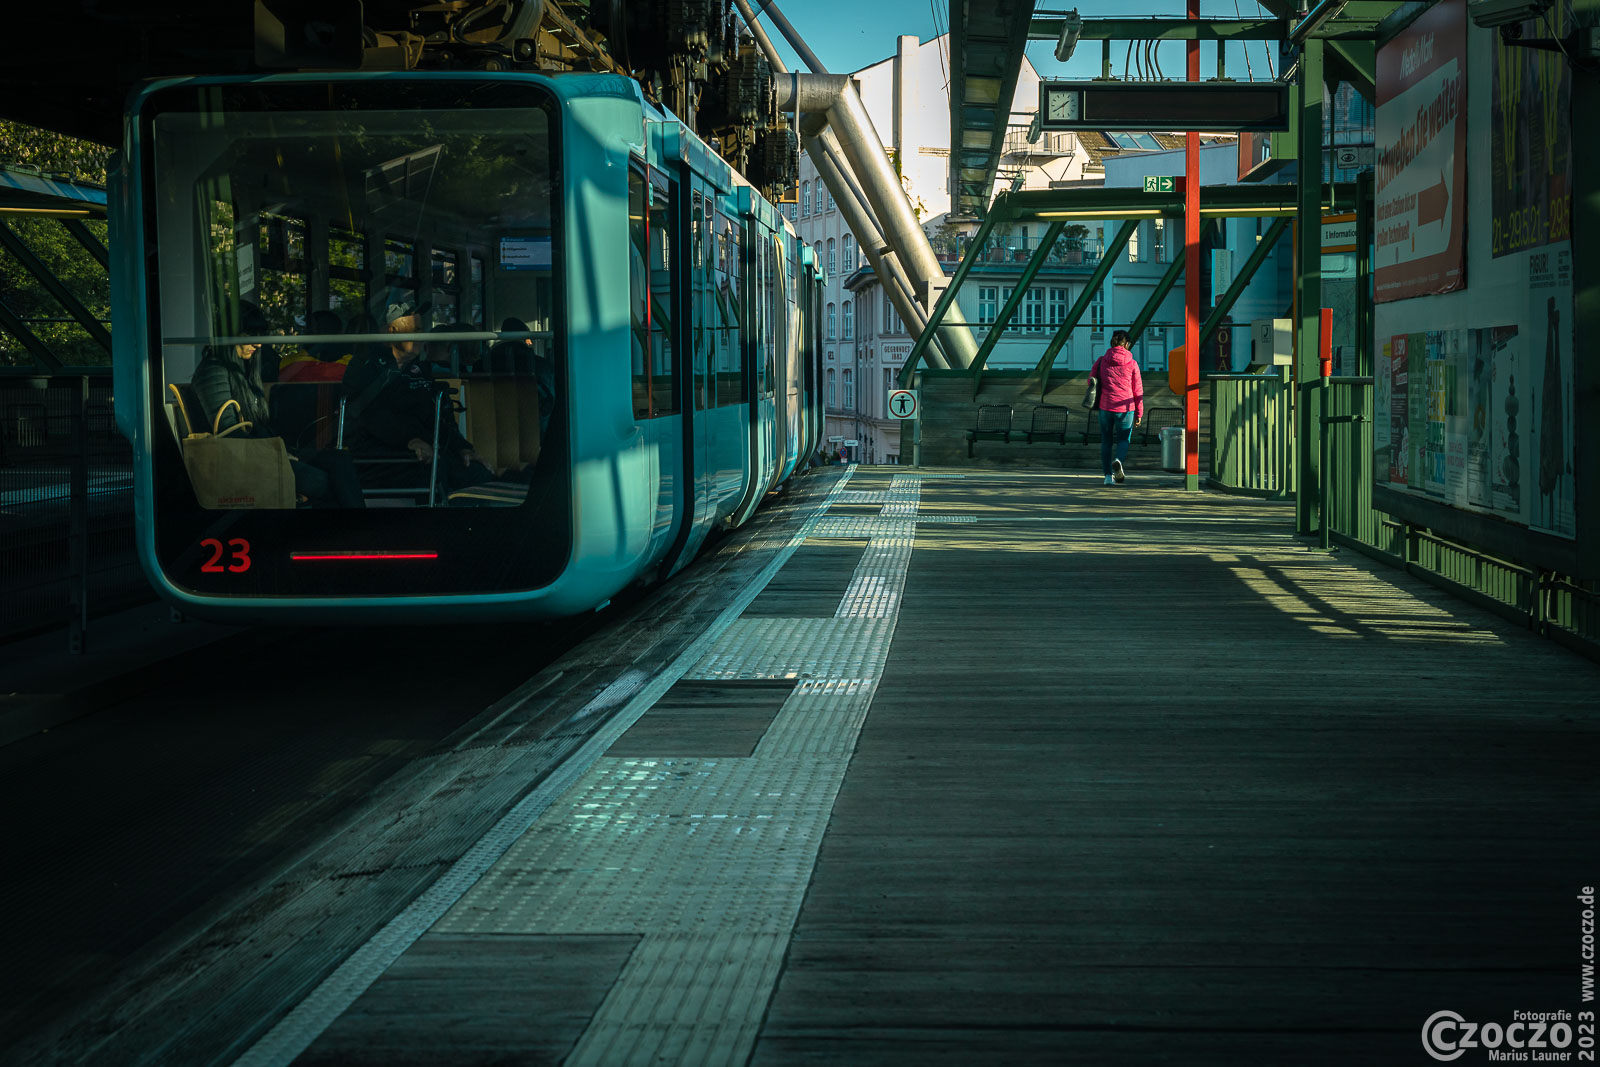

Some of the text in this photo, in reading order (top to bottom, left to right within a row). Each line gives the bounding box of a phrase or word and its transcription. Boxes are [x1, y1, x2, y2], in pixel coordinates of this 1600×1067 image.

[1376, 75, 1460, 194] Schweben Sie weiter
[1329, 228, 1358, 240] Informatio
[200, 538, 252, 573] 23
